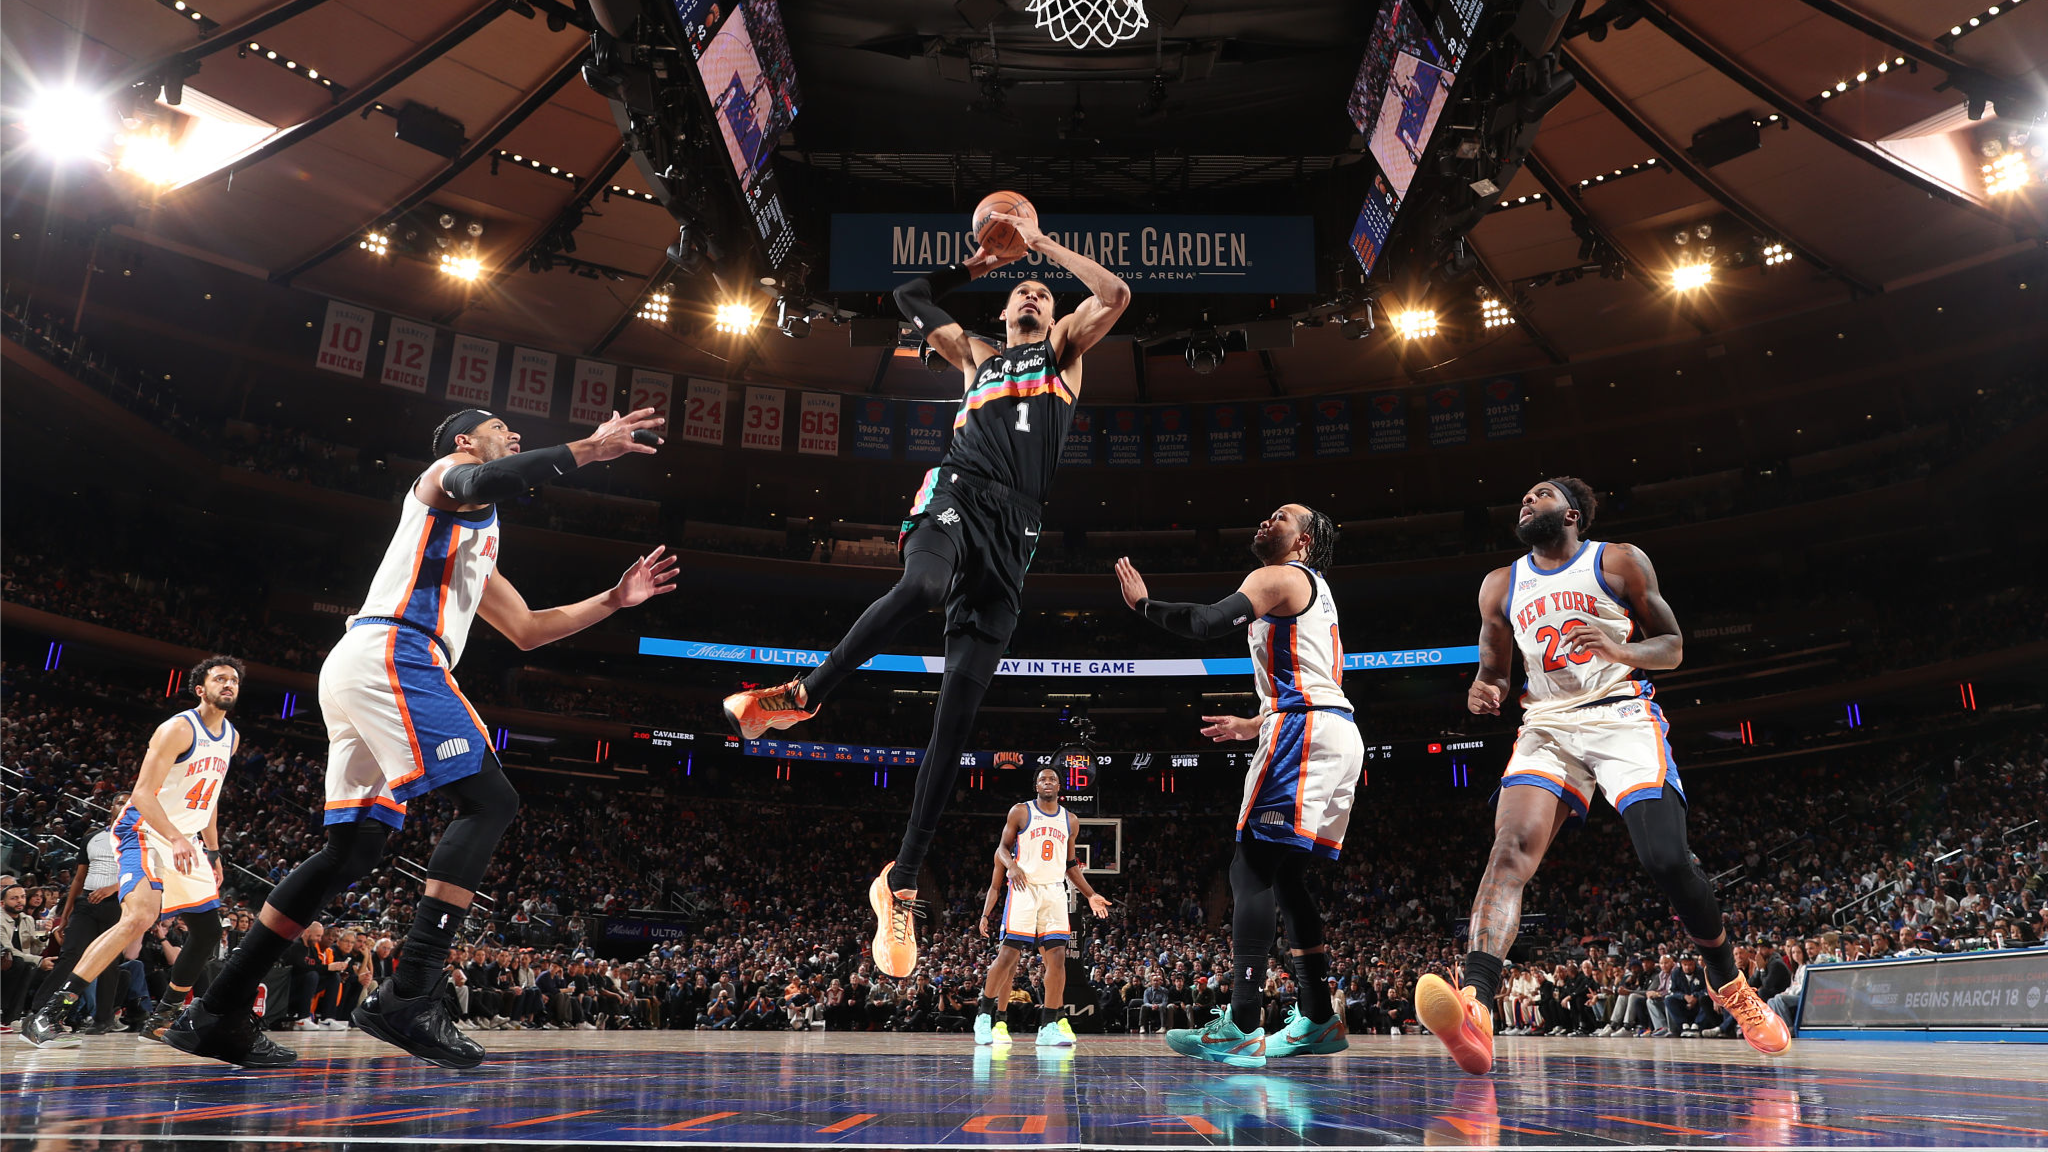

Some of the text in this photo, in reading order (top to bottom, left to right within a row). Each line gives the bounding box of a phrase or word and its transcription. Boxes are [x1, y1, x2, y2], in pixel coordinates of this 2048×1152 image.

[698, 25, 706, 40] 42
[1448, 38, 1456, 54] 29
[754, 186, 761, 198] 29
[1386, 193, 1392, 204] 42
[892, 226, 1246, 267] MADIS GARDEN
[1044, 271, 1073, 280] MOS
[1114, 271, 1143, 280] OUS
[329, 323, 362, 353] 10
[320, 352, 363, 373] KNICKS
[392, 340, 424, 370] 12
[457, 356, 489, 384] 15
[384, 368, 425, 388] KNICKS
[517, 367, 547, 395] 15
[449, 384, 489, 401] KNICKS
[579, 379, 608, 406] 19
[510, 395, 549, 412] KNICKS
[633, 388, 667, 416] 22
[1486, 403, 1520, 416] 2012-13
[572, 408, 610, 422] KNICKS
[688, 396, 721, 424] 24
[747, 405, 780, 430] 33
[1014, 401, 1030, 432] 1
[1431, 411, 1465, 423] 1998-99
[801, 410, 838, 436] 613
[858, 424, 891, 435] 1969-70
[1316, 423, 1350, 433] 1993-94
[685, 425, 721, 440] KNICKS
[744, 432, 780, 446] KNICKS
[910, 428, 943, 438] 1972-73
[1109, 434, 1141, 443] 1970-71
[1156, 434, 1188, 443] 1971-72
[1262, 427, 1295, 437] 1992-93
[801, 438, 836, 451] KNICKS
[856, 441, 889, 450] CHAMPIONS
[1517, 591, 1600, 634] NEW YORK
[686, 643, 746, 660] Michelob
[759, 649, 820, 665] ULTRA
[1343, 650, 1442, 668] LTRA ZERO
[997, 661, 1136, 673] AY IN THE GAME
[633, 730, 695, 740] 2:00 CAVALIERS
[652, 738, 672, 747] NETS
[1446, 741, 1484, 751] @NYKNICKS
[810, 751, 827, 759] 42.1
[960, 752, 1112, 767] CKS KNICKS 42 29
[1066, 755, 1090, 766] 4:24
[1171, 758, 1198, 767] SPURS
[184, 756, 211, 777] NEW
[1070, 767, 1088, 786] 16
[184, 778, 218, 810] 44
[1030, 827, 1066, 844] NEW YORK
[1041, 840, 1054, 861] 8
[651, 928, 684, 938] ULTRA
[1904, 991, 1950, 1008] BEGINS
[1952, 988, 2001, 1007] MARCH
[2005, 987, 2020, 1006] 18
